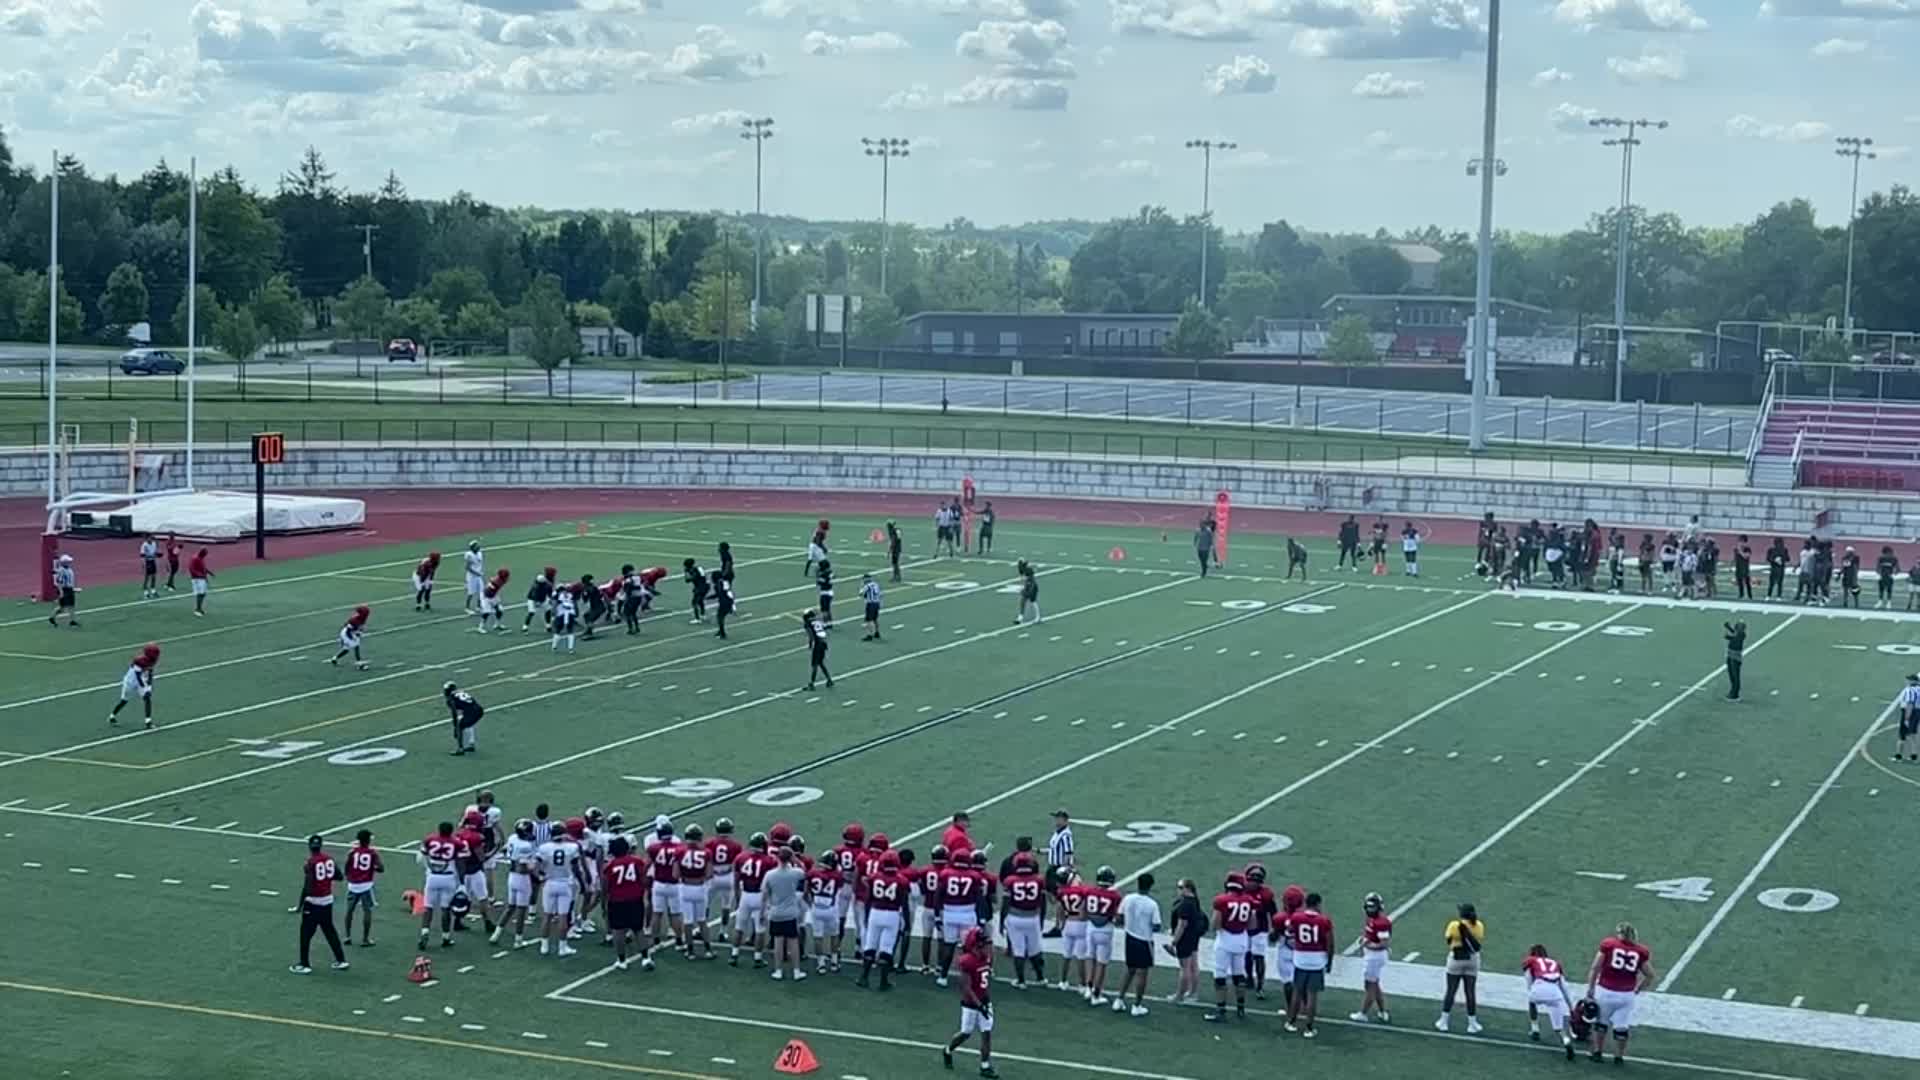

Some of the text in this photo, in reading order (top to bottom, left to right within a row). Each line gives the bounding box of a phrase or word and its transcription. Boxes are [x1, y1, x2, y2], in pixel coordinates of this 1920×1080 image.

[429, 841, 455, 859] 23
[553, 849, 565, 866] 8
[681, 850, 705, 869] 45
[315, 859, 336, 880] 89
[353, 852, 371, 871] 19
[741, 858, 762, 878] 41
[612, 863, 637, 885] 74
[811, 878, 836, 895] 34
[873, 879, 897, 900] 64
[947, 876, 973, 896] 67
[1013, 881, 1039, 901] 53
[1087, 895, 1112, 914] 87
[1227, 901, 1251, 922] 78
[1299, 924, 1319, 943] 61
[1611, 948, 1640, 972] 63
[783, 1045, 801, 1068] 30
